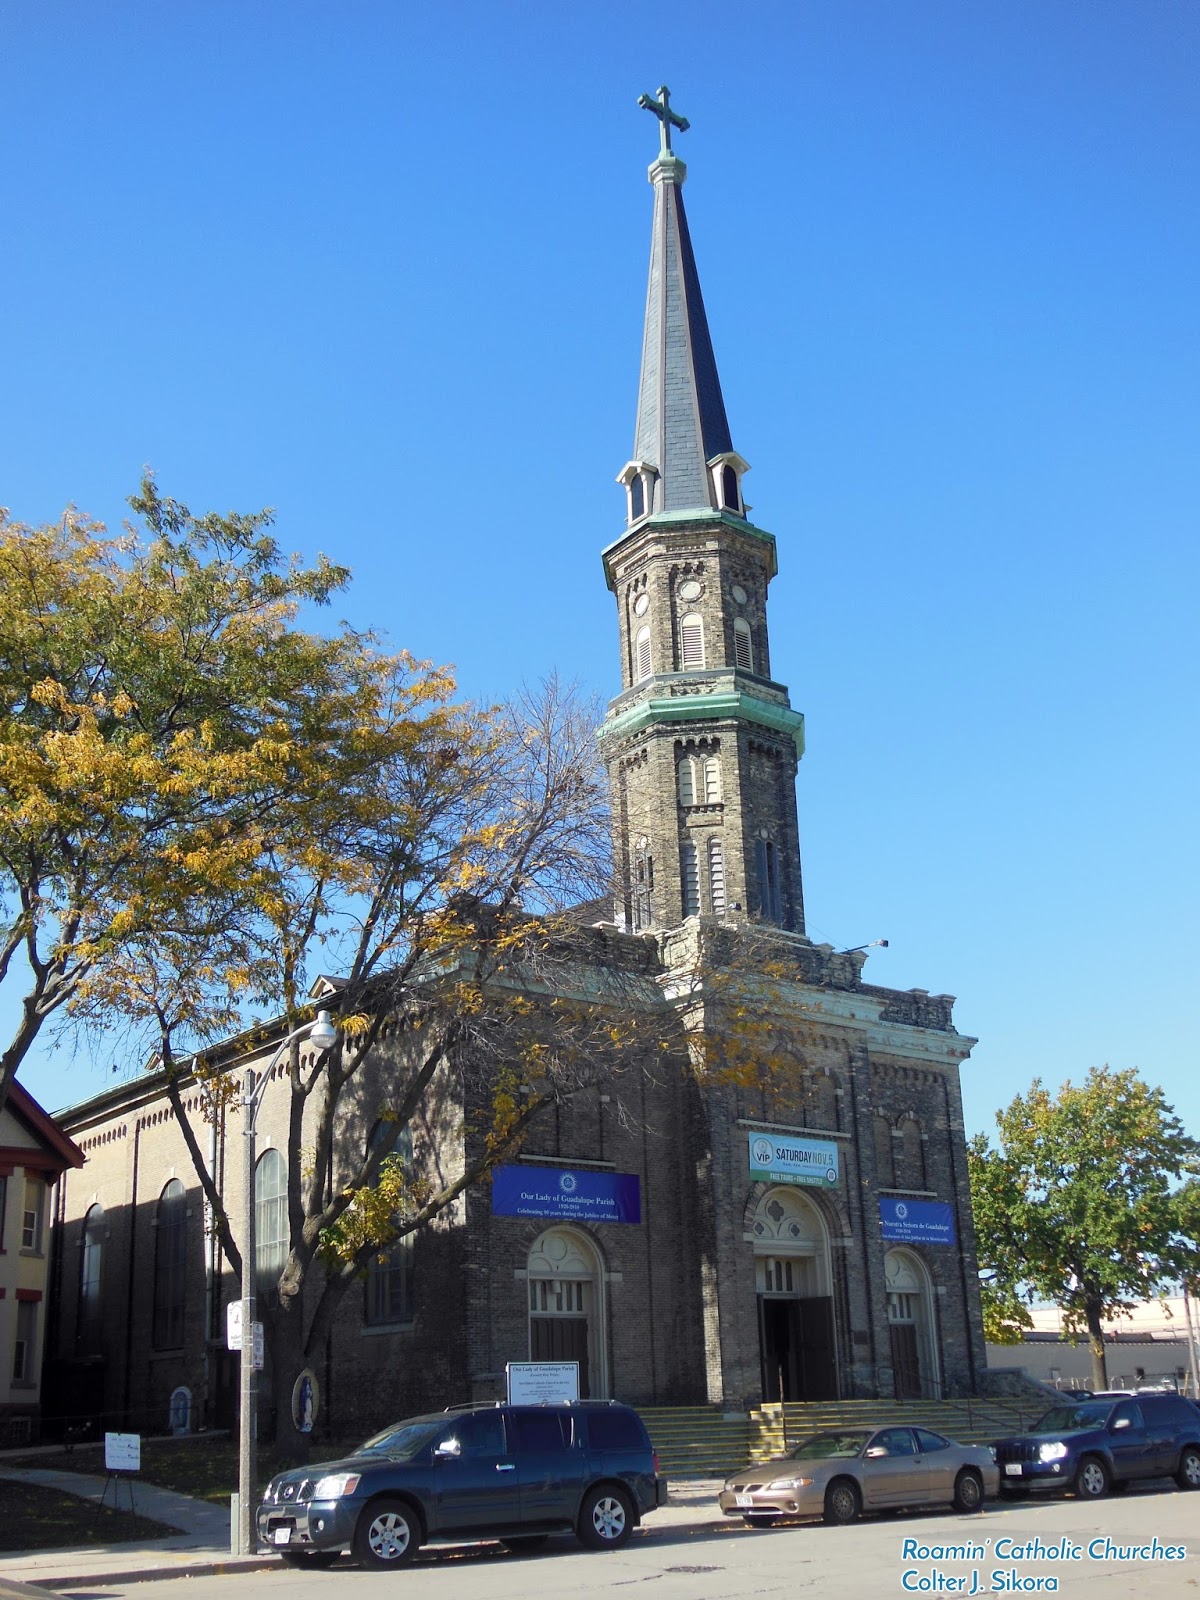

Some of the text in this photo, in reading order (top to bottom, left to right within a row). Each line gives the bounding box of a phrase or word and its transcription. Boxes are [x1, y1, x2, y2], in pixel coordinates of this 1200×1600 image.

[756, 1153, 770, 1162] VIP
[776, 1148, 812, 1164] SATURDAY
[770, 1172, 823, 1185] FREE TOURS FREE SHUTTLE
[520, 1192, 615, 1206] Our Lady of Guadalupe Parish
[517, 1208, 543, 1216] Celebrating
[562, 1210, 577, 1218] during
[884, 1220, 902, 1228] Nuestra
[902, 1221, 919, 1229] Señora
[925, 1223, 949, 1232] Guadalupe
